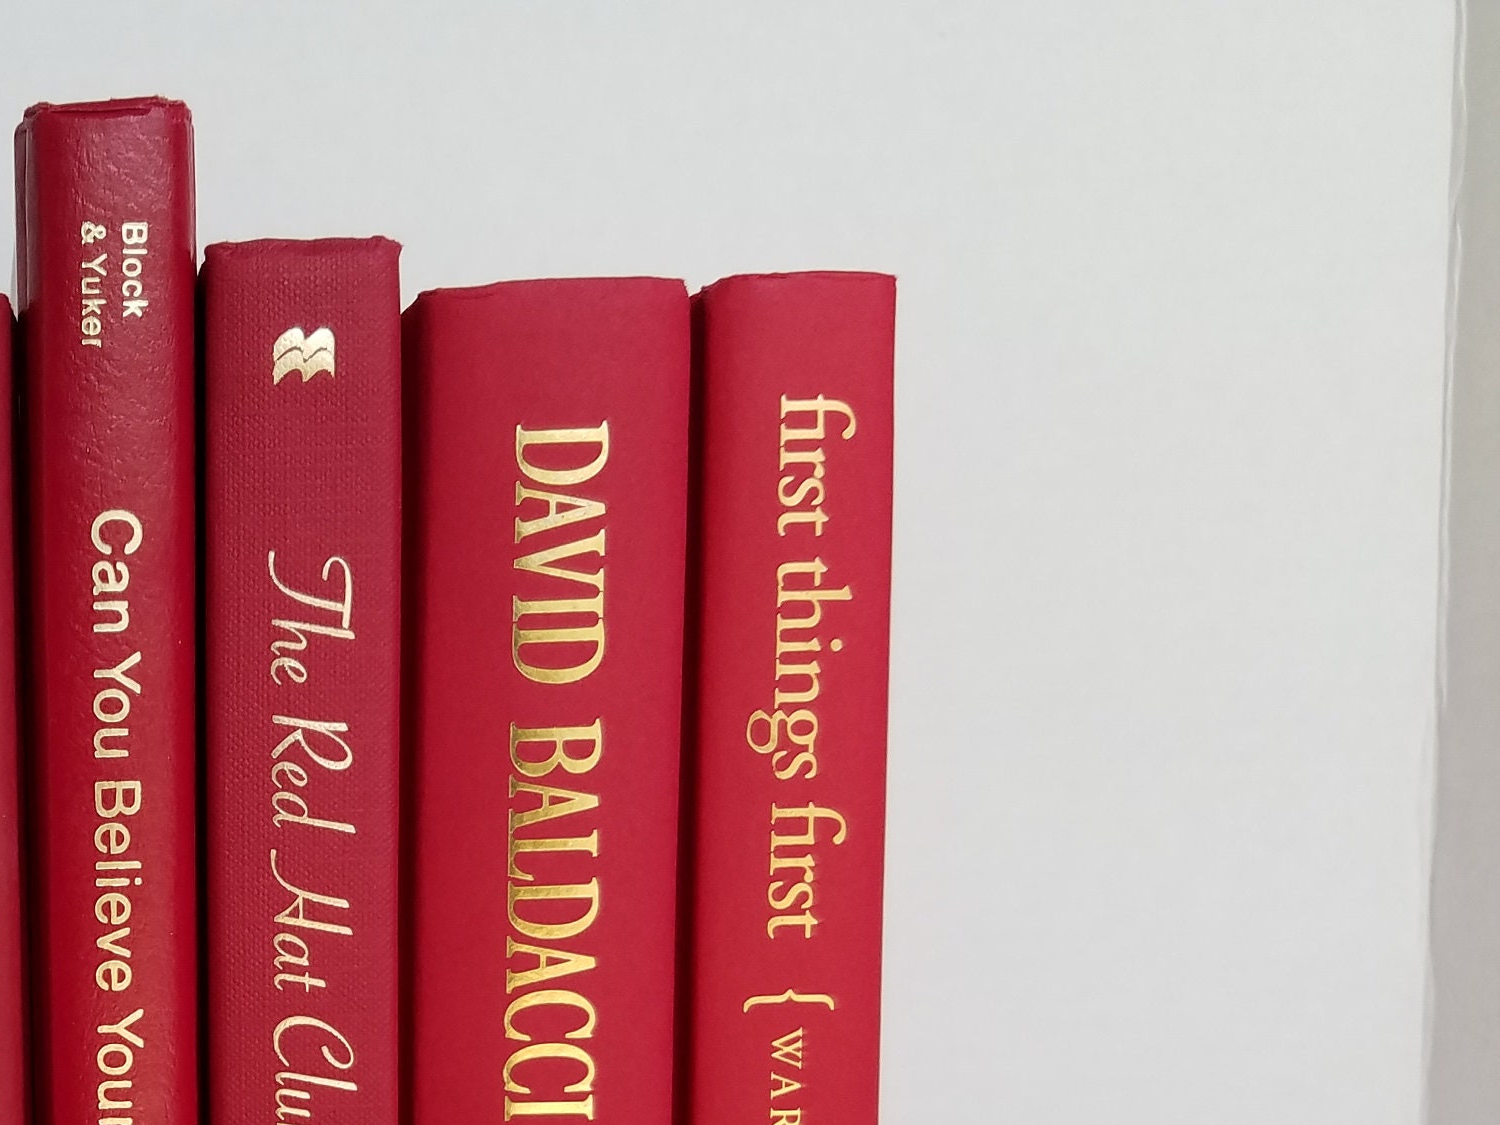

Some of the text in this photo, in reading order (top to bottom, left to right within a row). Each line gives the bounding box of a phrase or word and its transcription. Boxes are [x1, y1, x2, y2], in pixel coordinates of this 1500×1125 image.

[80, 220, 109, 349] & Yuker
[121, 220, 151, 319] Block
[90, 508, 144, 633] Can
[267, 550, 356, 686] The
[92, 650, 142, 759] You
[746, 393, 858, 940] first things first
[270, 714, 357, 835] Red
[502, 419, 612, 1122] DAVID BALDACCI
[93, 779, 143, 992] Believe
[270, 848, 354, 993] Hat
